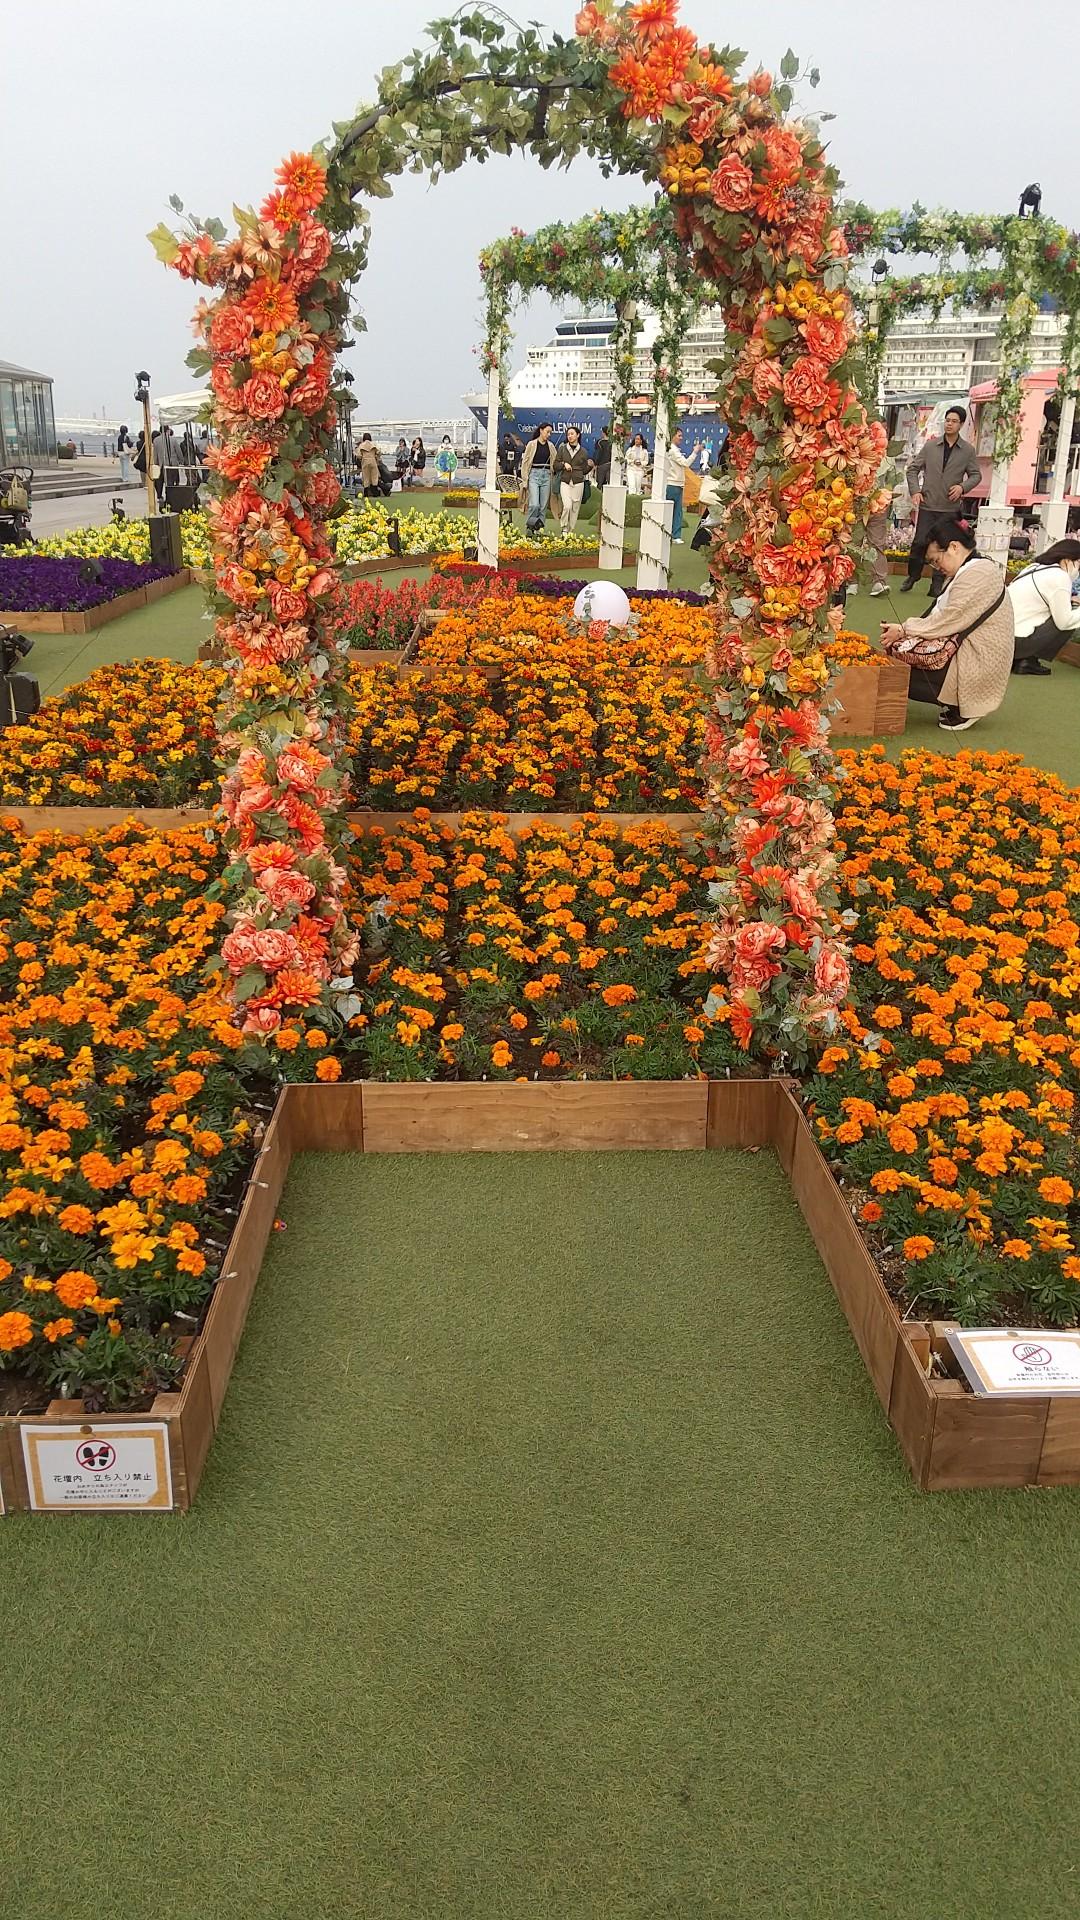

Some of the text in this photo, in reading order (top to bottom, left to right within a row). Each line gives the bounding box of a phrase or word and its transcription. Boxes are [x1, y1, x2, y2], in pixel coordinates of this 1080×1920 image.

[93, 1473, 152, 1481] 立ち入り禁止
